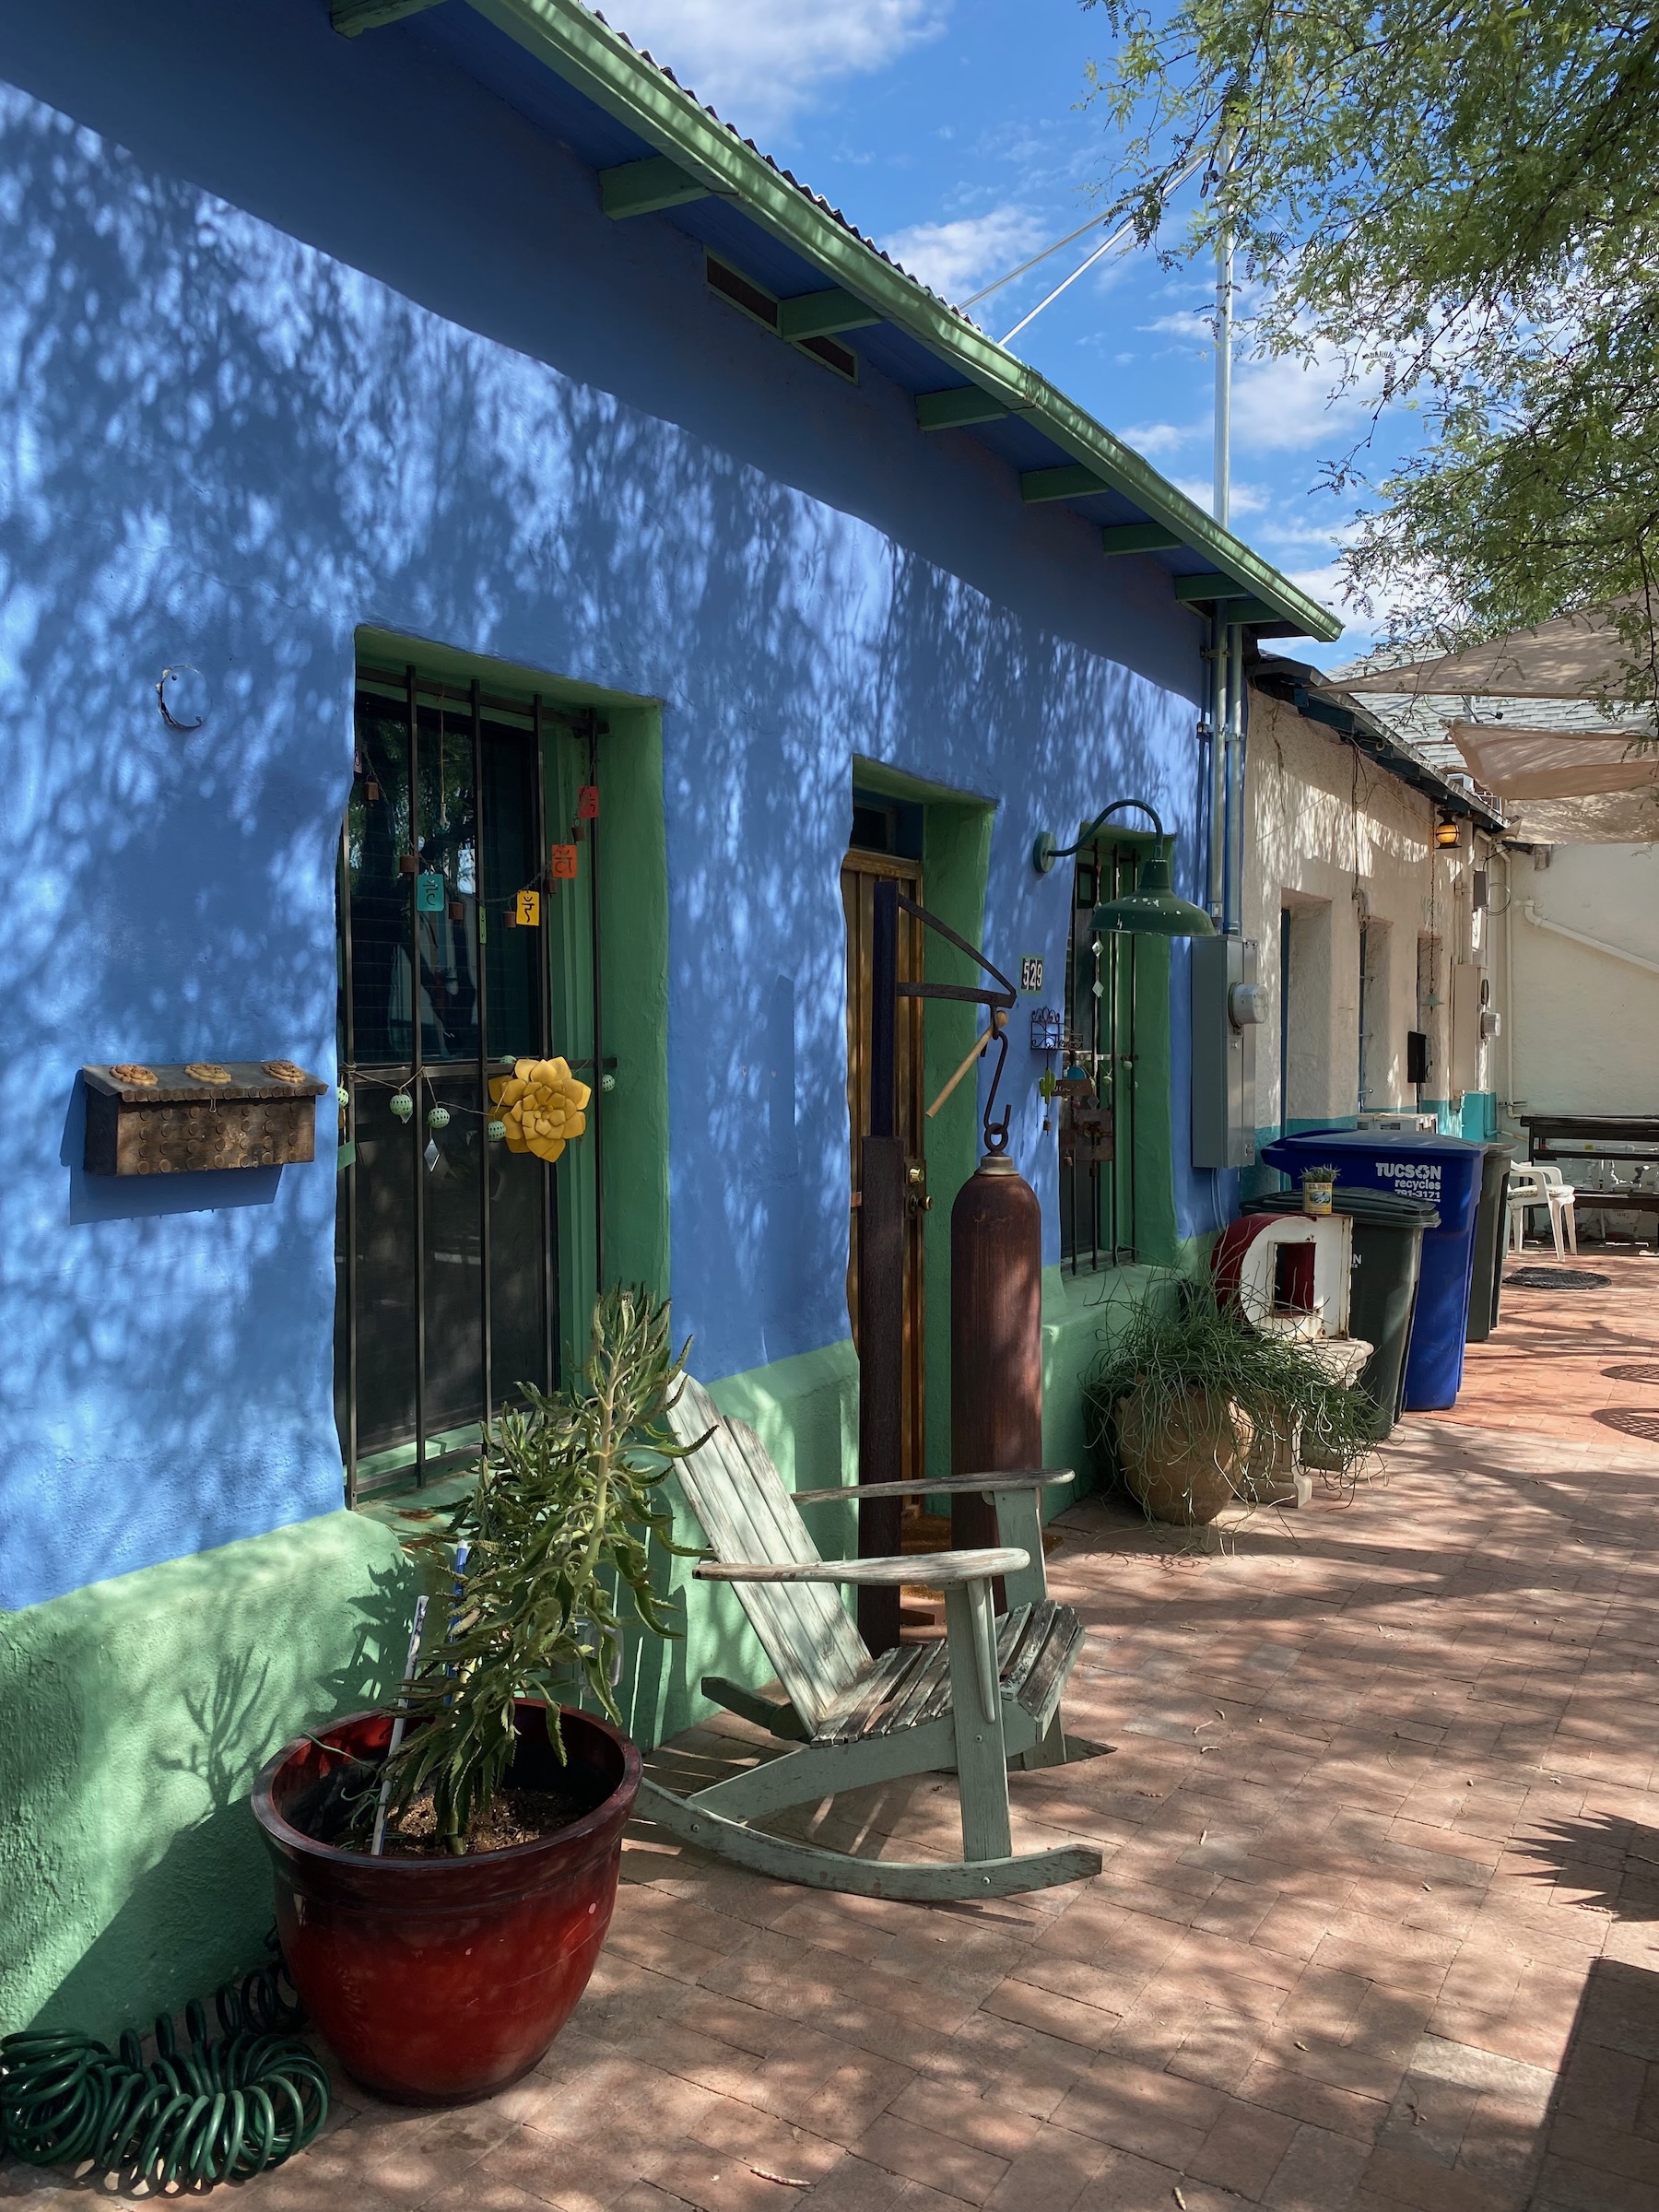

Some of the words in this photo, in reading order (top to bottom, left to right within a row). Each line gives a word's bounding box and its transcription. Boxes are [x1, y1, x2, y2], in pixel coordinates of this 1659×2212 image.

[1023, 959, 1042, 991] 529
[1375, 1162, 1441, 1180] TUCSON
[1394, 1179, 1441, 1190] recycles
